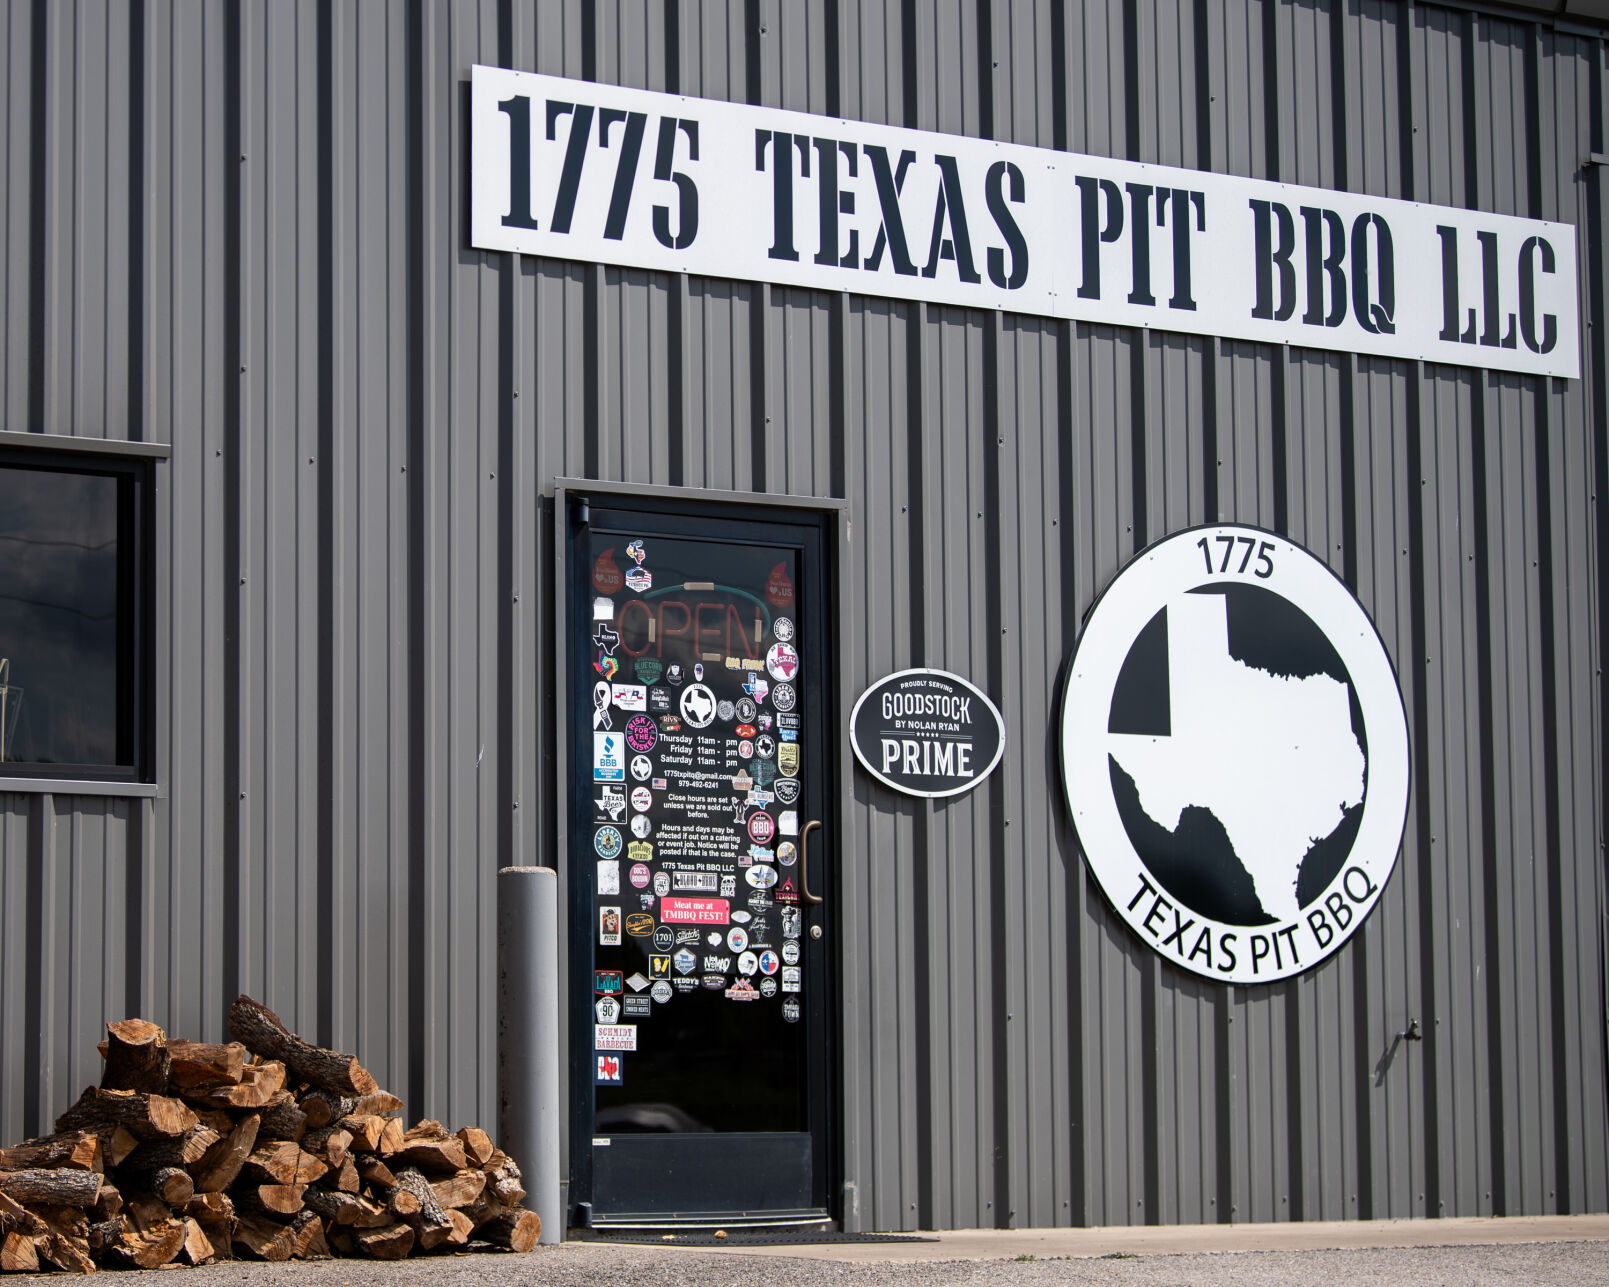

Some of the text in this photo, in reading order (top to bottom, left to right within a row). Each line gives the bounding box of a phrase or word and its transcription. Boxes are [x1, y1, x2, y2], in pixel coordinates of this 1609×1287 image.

[499, 95, 1558, 355] 1775 TEXAS PIT BBQ LLC
[1197, 536, 1276, 579] 1775
[617, 600, 762, 660] OPEN
[900, 680, 953, 693] PROUDLY SERVING
[882, 692, 972, 724] GOODSTOCK
[628, 717, 655, 731] RISK IT
[895, 720, 960, 732] BY NOLAN RYAN
[627, 735, 655, 751] BRISKET
[659, 733, 693, 745] Thursday
[697, 736, 716, 745] 11am
[725, 739, 738, 747] pm
[670, 744, 693, 755] Friday
[697, 746, 716, 755] 11am
[725, 749, 738, 757] pm
[599, 758, 617, 767] BBB
[660, 754, 693, 766] Saturday
[697, 757, 716, 765] 11am
[725, 760, 738, 768] pm
[881, 739, 974, 777] PRIME
[668, 793, 686, 801] Close
[687, 794, 706, 802] hours
[687, 810, 710, 819] before.
[597, 828, 620, 842] LIBERTY
[661, 823, 681, 831] Hours
[695, 825, 710, 834] days
[711, 827, 725, 835] may
[726, 826, 734, 834] be
[655, 831, 682, 839] affected
[715, 834, 741, 843] catering
[684, 841, 696, 849] job.
[697, 841, 718, 849] Notice
[718, 842, 730, 850] will
[659, 848, 682, 856] posted
[661, 861, 735, 872] 1775 Texas Pit BBQ LLC
[673, 900, 692, 909] Meat
[705, 902, 713, 910] at
[663, 909, 724, 921] TMBBQ FEST!
[1127, 866, 1378, 974] TEXAS PIT BBQ
[655, 933, 672, 942] 1701
[672, 977, 699, 985] TEDDY'S
[598, 1027, 633, 1037] SCHMIDT
[596, 1040, 634, 1049] BARBECUE
